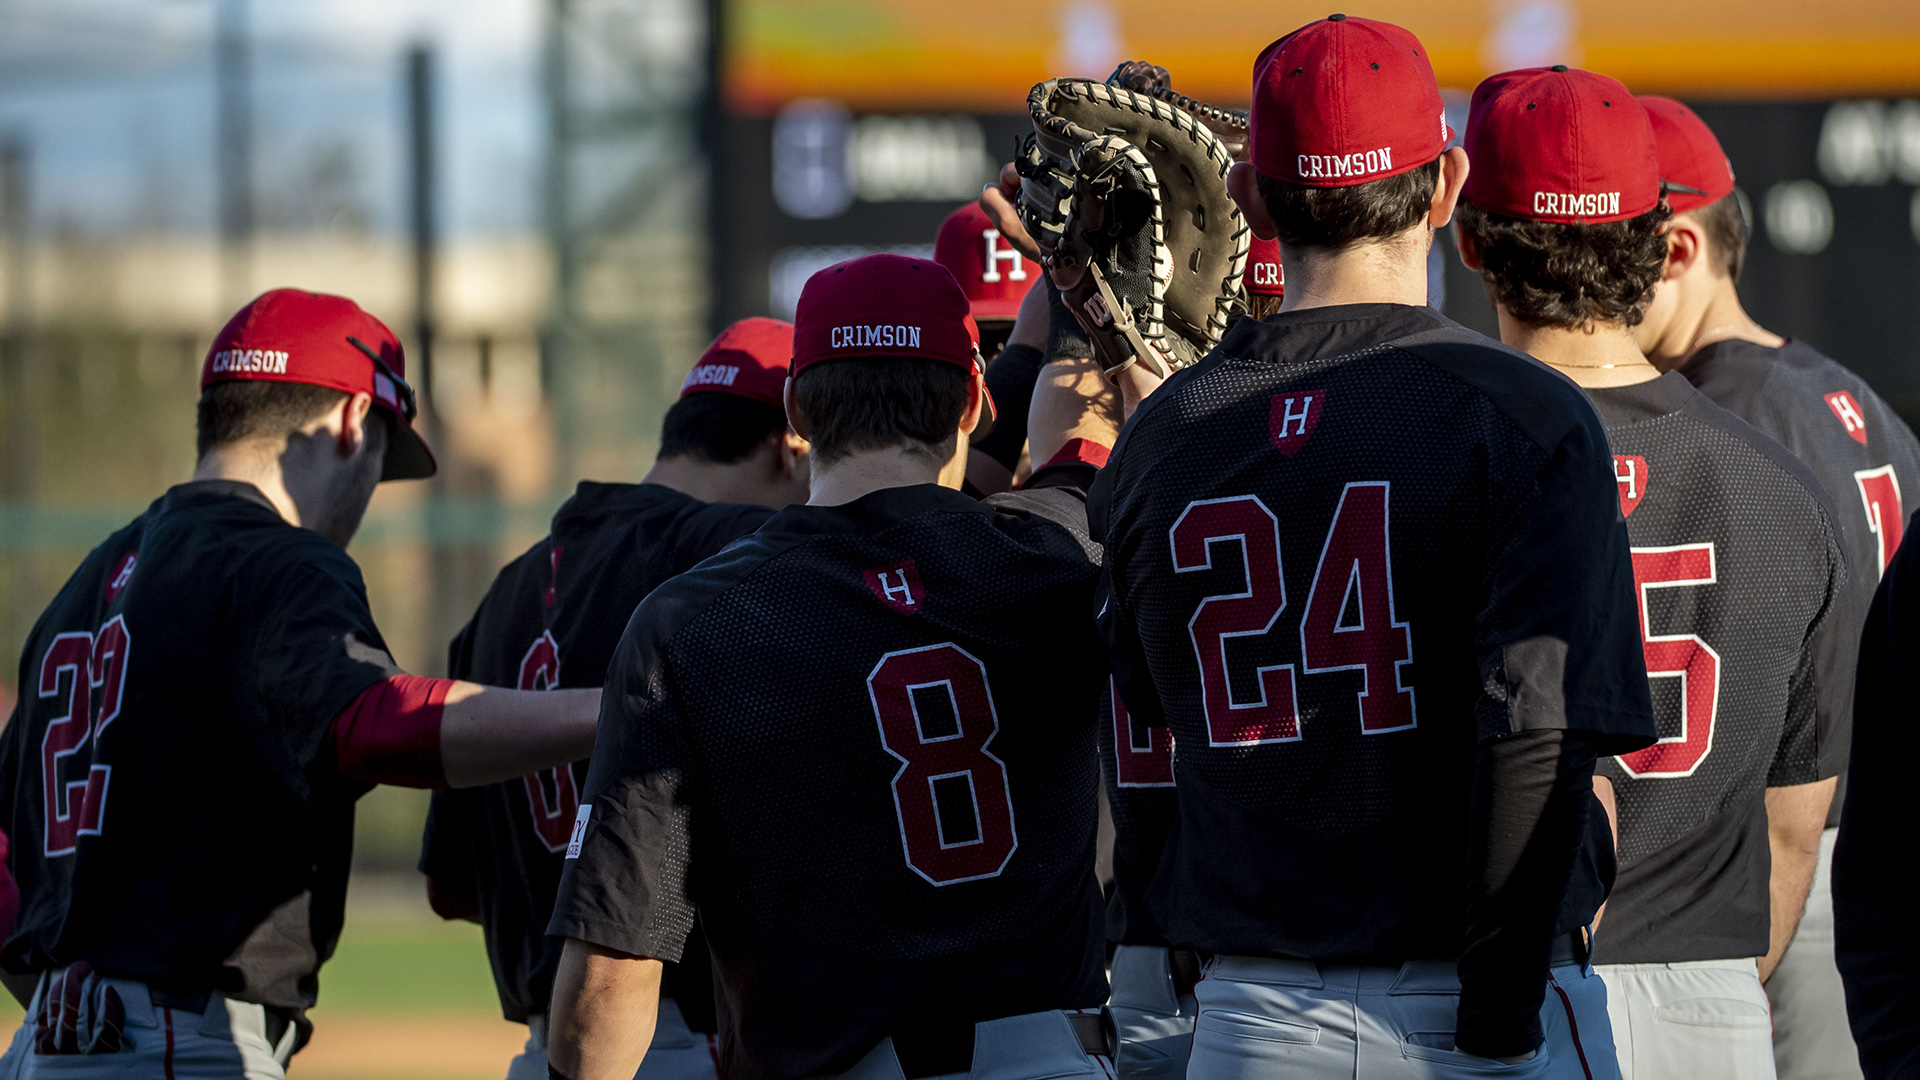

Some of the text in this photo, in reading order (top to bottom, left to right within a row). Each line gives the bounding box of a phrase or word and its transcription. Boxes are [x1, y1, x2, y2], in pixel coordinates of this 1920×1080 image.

[1297, 146, 1392, 178] CRIMSON
[1533, 191, 1620, 216] CRIMSON
[982, 228, 1027, 283] H
[831, 324, 921, 348] CRIMSON
[212, 348, 289, 374] CRIMSON
[1278, 395, 1313, 439] H
[1831, 394, 1865, 432] H
[111, 555, 138, 588] H
[877, 568, 916, 605] H
[1169, 480, 1417, 747] 24
[39, 614, 131, 857] 22
[867, 642, 1018, 887] 8
